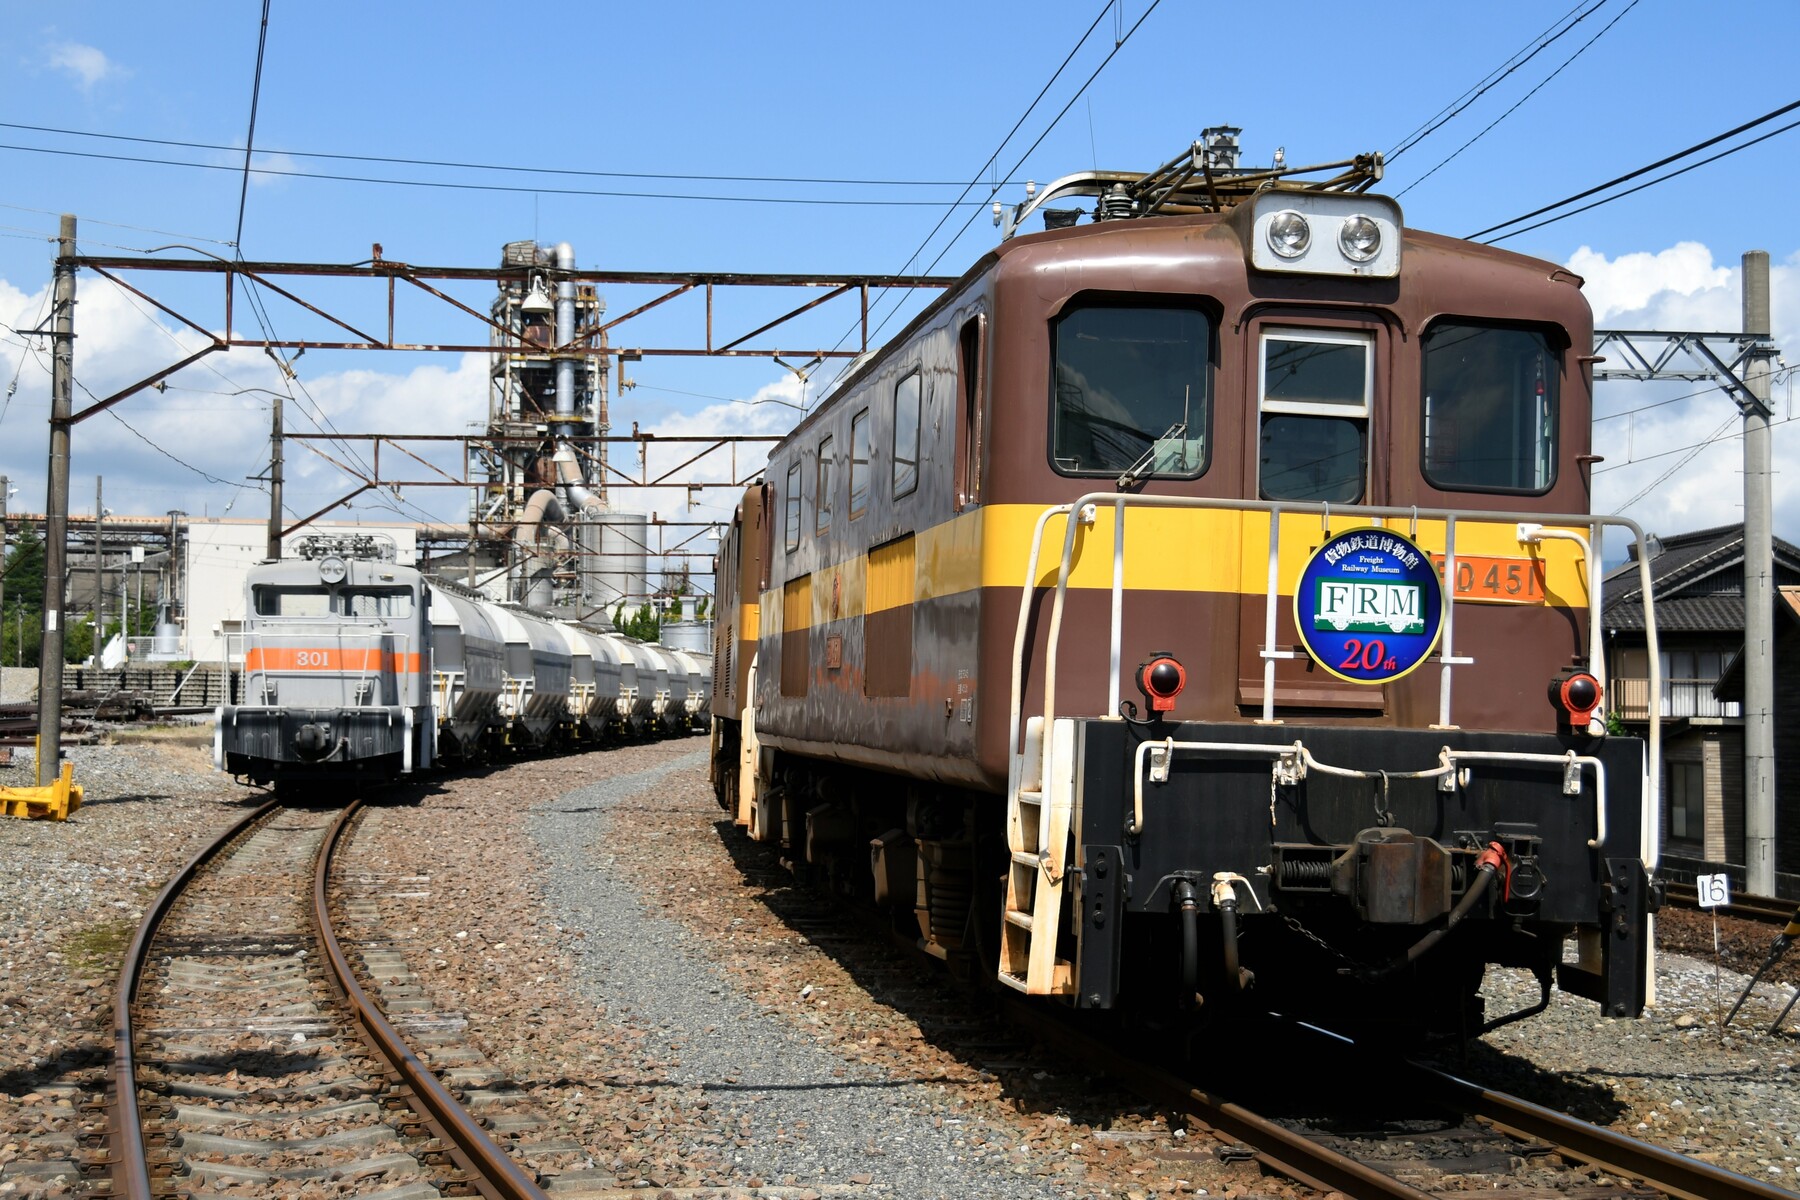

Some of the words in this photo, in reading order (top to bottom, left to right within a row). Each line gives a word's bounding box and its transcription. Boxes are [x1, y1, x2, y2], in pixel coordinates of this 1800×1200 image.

[1324, 535, 1419, 570] 貨物鉄道博物館
[1359, 556, 1384, 564] Freight
[1342, 564, 1368, 573] Railway
[1371, 565, 1400, 574] Museum
[1325, 585, 1416, 616] FRM
[296, 651, 329, 666] 301
[1339, 639, 1396, 670] 20th
[1701, 879, 1725, 902] 16
